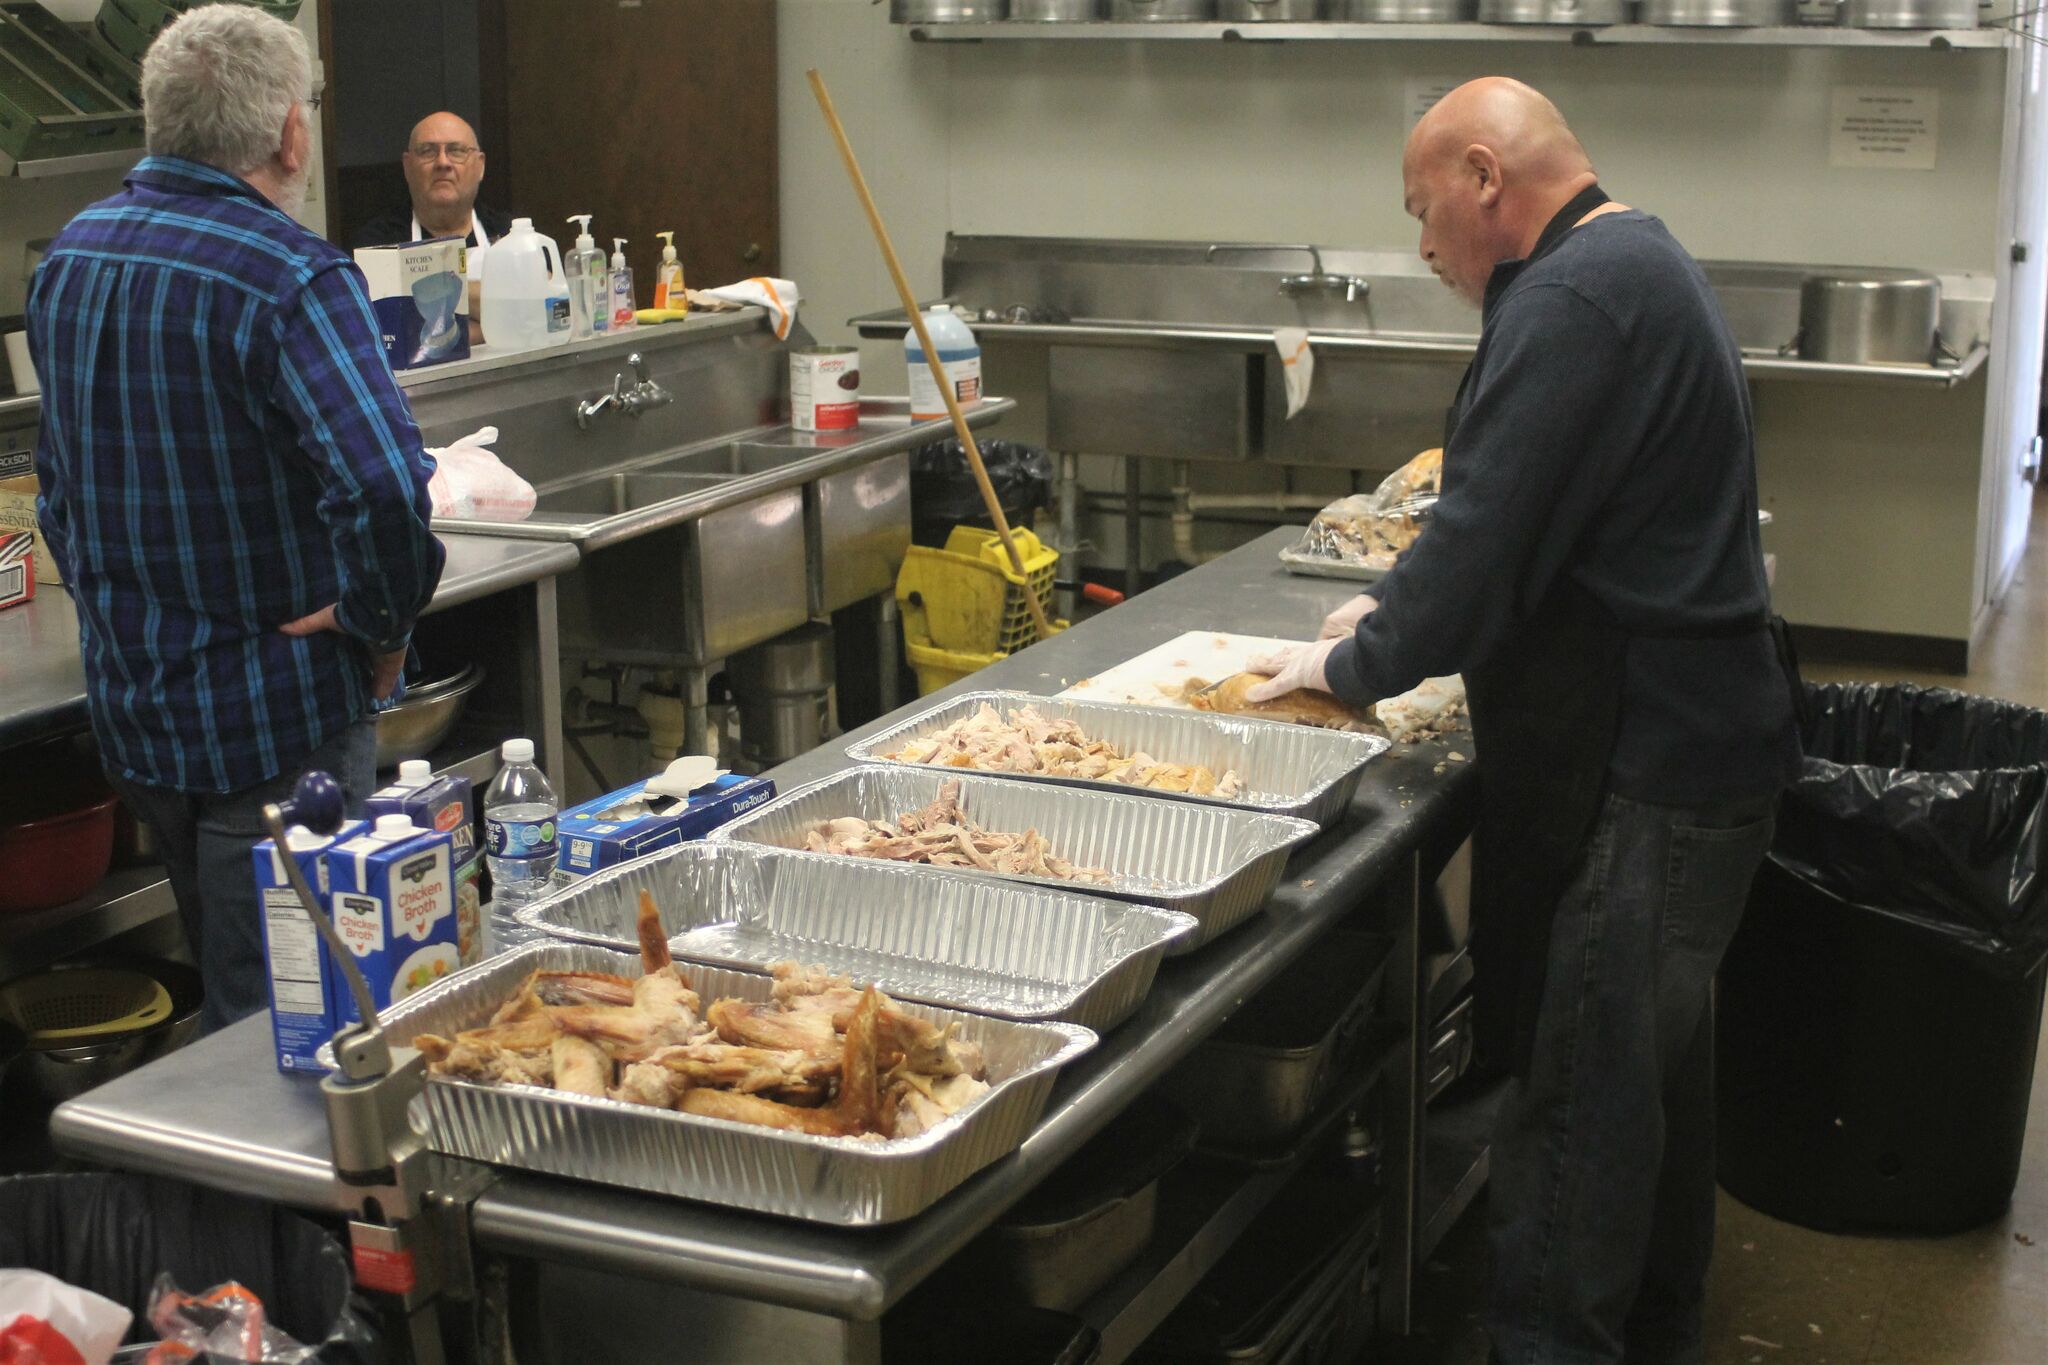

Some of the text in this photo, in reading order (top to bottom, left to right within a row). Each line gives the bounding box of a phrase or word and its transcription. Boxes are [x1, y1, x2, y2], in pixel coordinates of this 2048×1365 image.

[405, 255, 433, 265] KITCHEN
[409, 265, 429, 273] SCALE
[0, 454, 30, 468] ACKSON
[0, 515, 38, 528] SSENTIA
[732, 789, 770, 814] Dura-Touch
[398, 881, 442, 908] Chicken
[404, 898, 437, 921] Broth
[340, 916, 379, 930] Chicken
[346, 927, 374, 941] Broth
